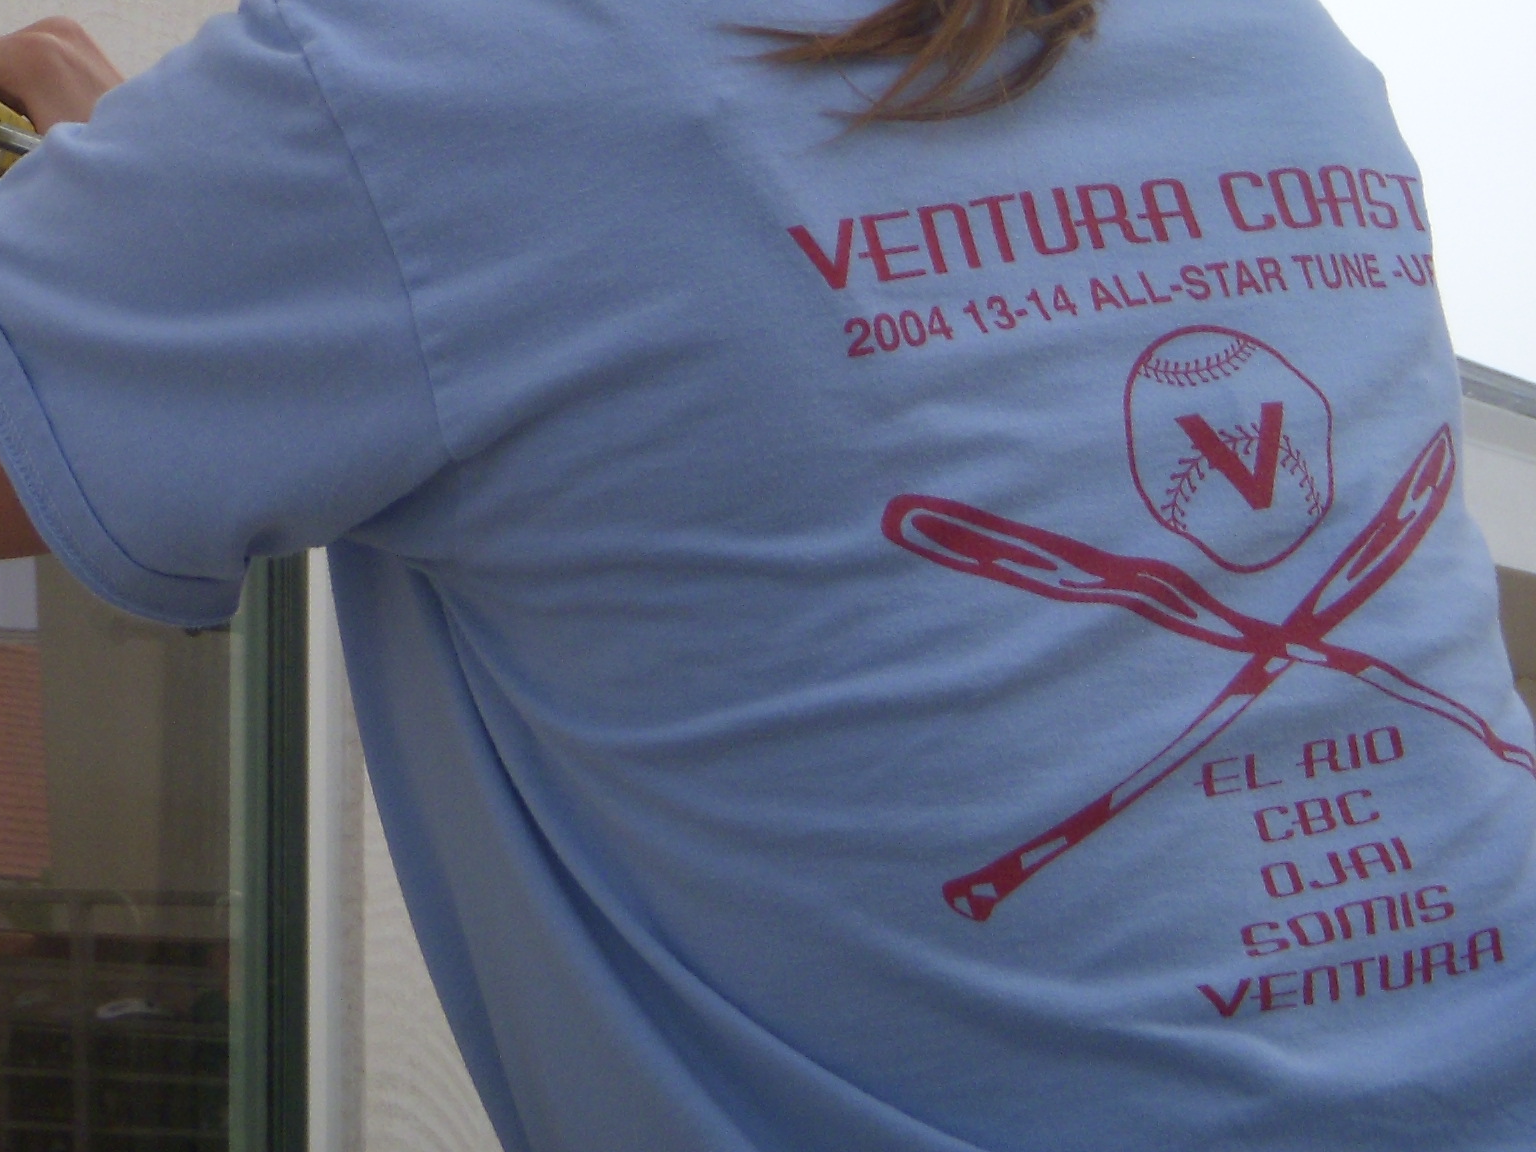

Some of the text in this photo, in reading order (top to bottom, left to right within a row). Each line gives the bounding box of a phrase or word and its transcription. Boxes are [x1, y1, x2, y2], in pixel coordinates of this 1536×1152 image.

[787, 164, 1426, 290] VENTURA COAST
[843, 305, 954, 358] 2004
[973, 288, 1078, 336] 13-14
[1089, 256, 1288, 312] ALL-STAR
[1291, 252, 1387, 290] TUNE
[1174, 401, 1284, 511] V
[1194, 725, 1405, 798] EL RIO
[1253, 788, 1381, 844] CBC
[1260, 836, 1413, 900] OJAI
[1240, 884, 1456, 958] SOMIS
[1196, 926, 1506, 1019] VENTURA
